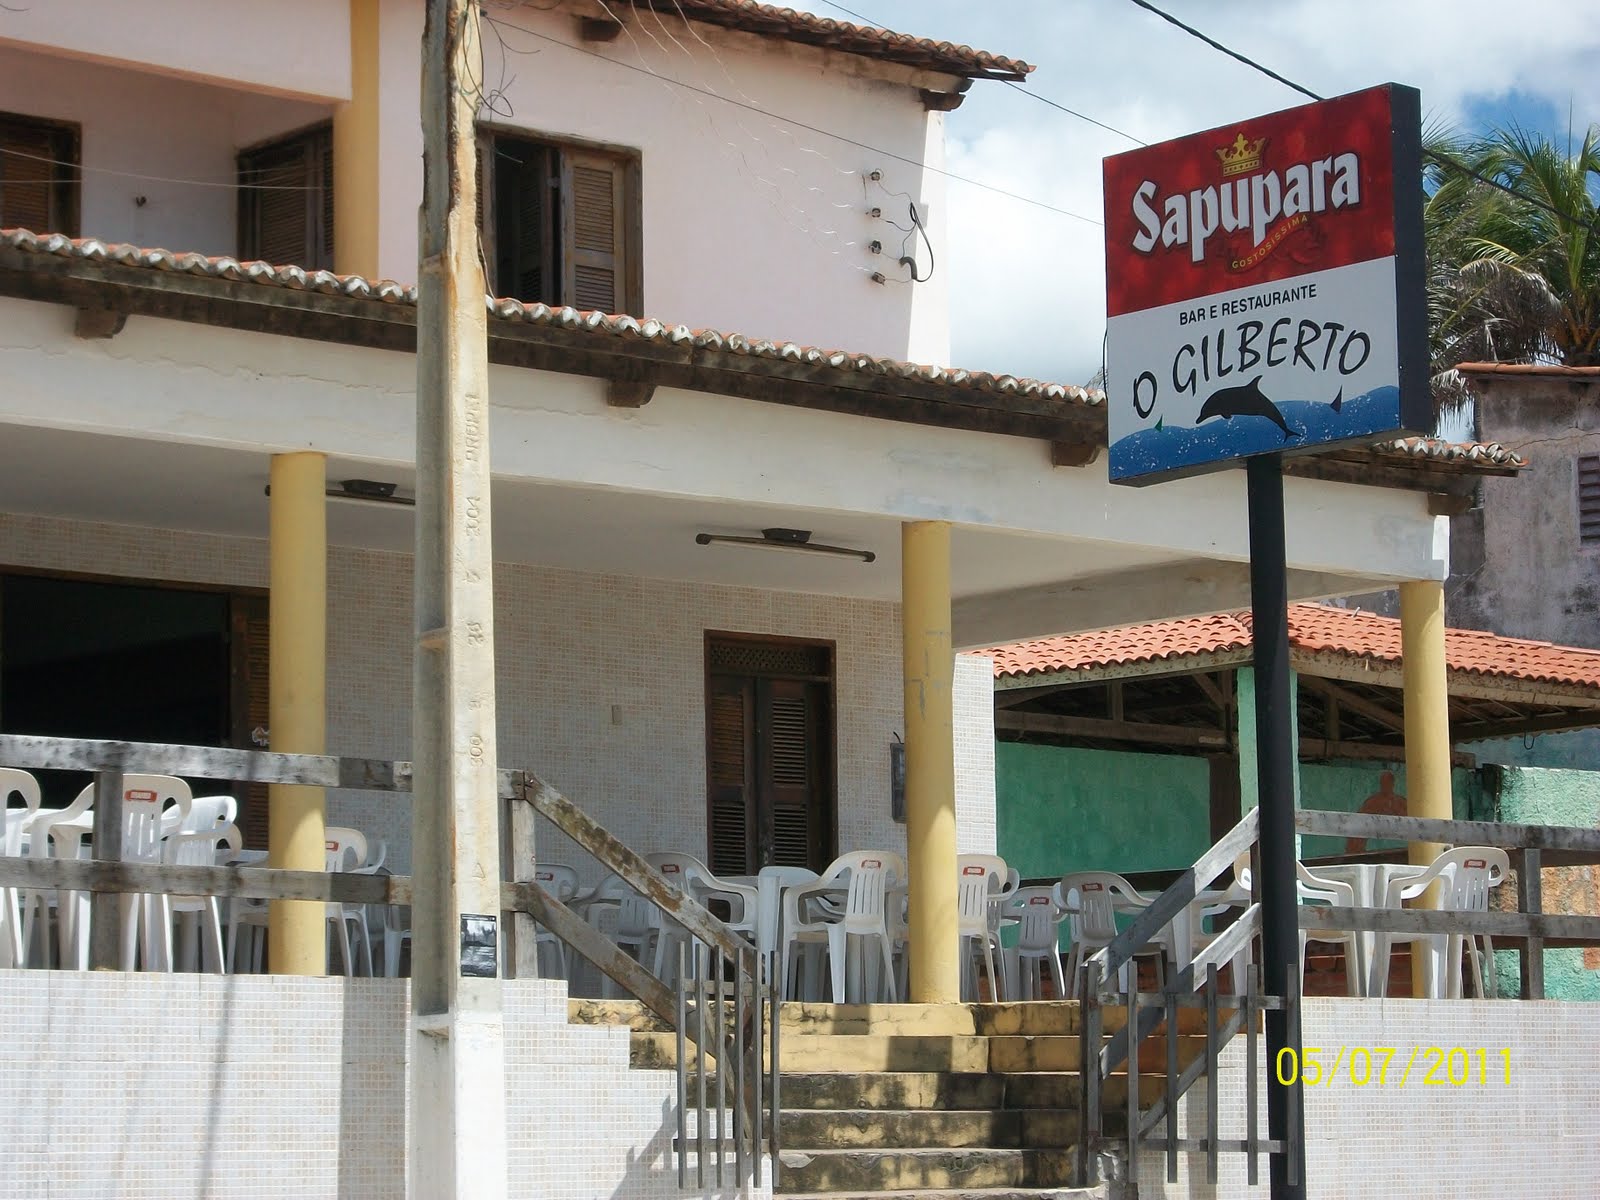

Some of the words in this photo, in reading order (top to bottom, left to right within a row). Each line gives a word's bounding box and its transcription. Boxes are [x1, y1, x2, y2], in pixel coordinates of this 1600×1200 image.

[1132, 152, 1360, 263] Sapupara
[1231, 214, 1308, 269] GOSTOSISSIMA
[1179, 307, 1206, 326] BAR
[1210, 304, 1218, 319] E
[1221, 283, 1317, 316] RESTAURANTE
[1132, 370, 1158, 419] O
[1172, 317, 1371, 397] GILBERTO
